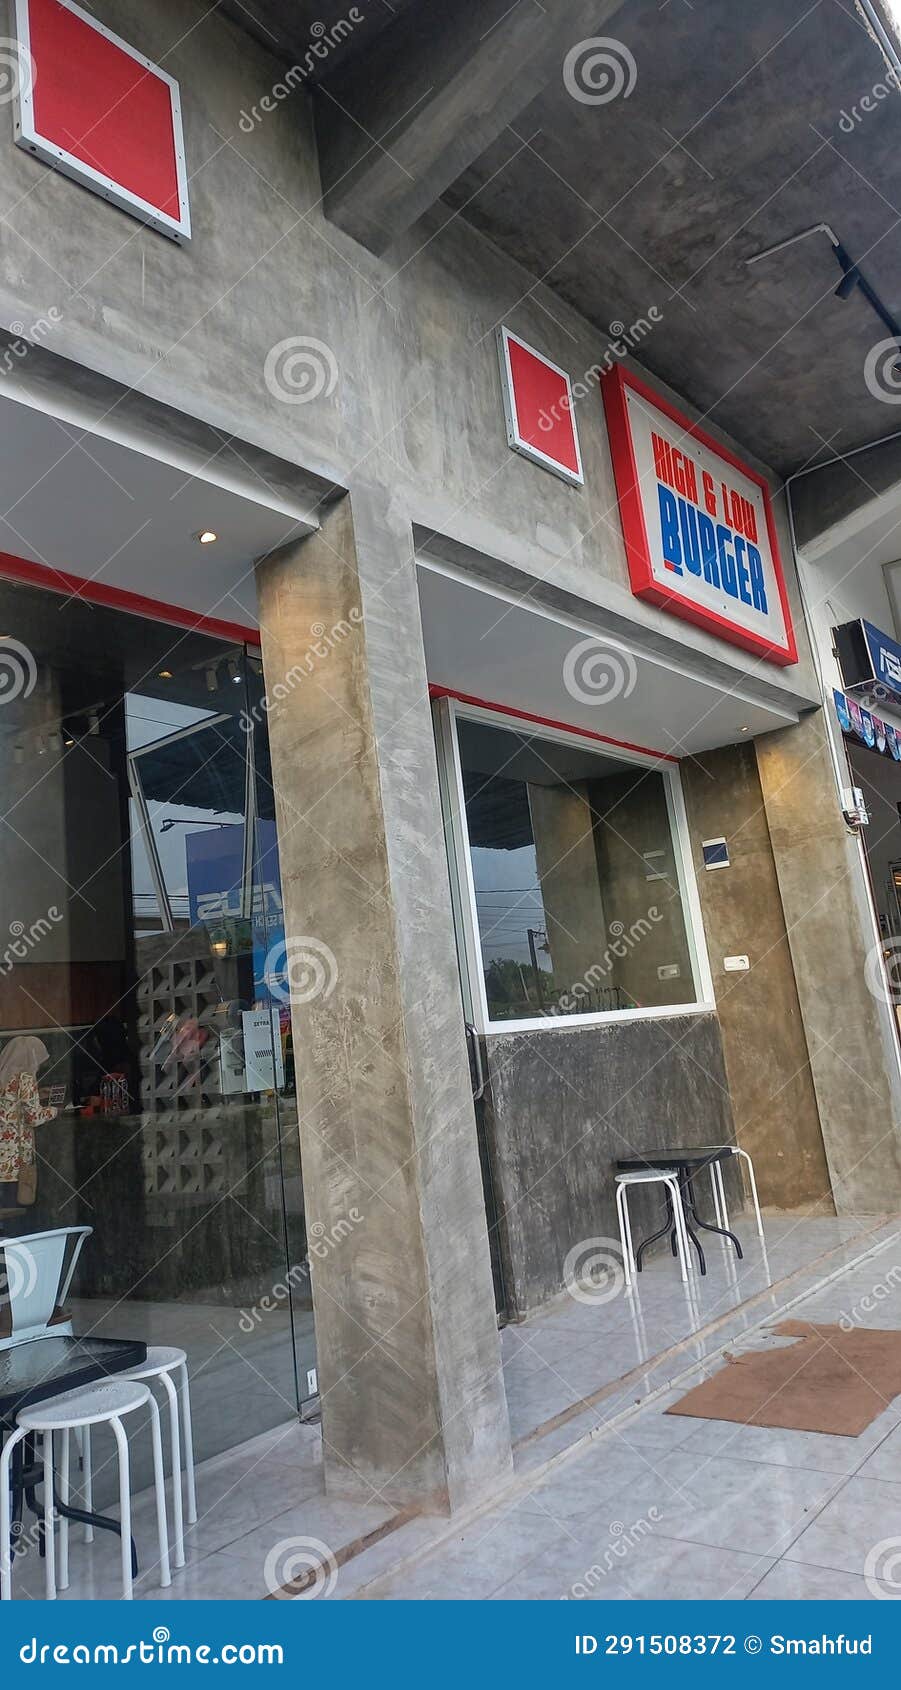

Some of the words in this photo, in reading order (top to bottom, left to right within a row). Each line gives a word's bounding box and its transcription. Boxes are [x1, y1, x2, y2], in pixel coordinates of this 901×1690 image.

[651, 431, 698, 505] HIGH
[721, 482, 758, 545] LOW
[657, 482, 769, 616] BURGER
